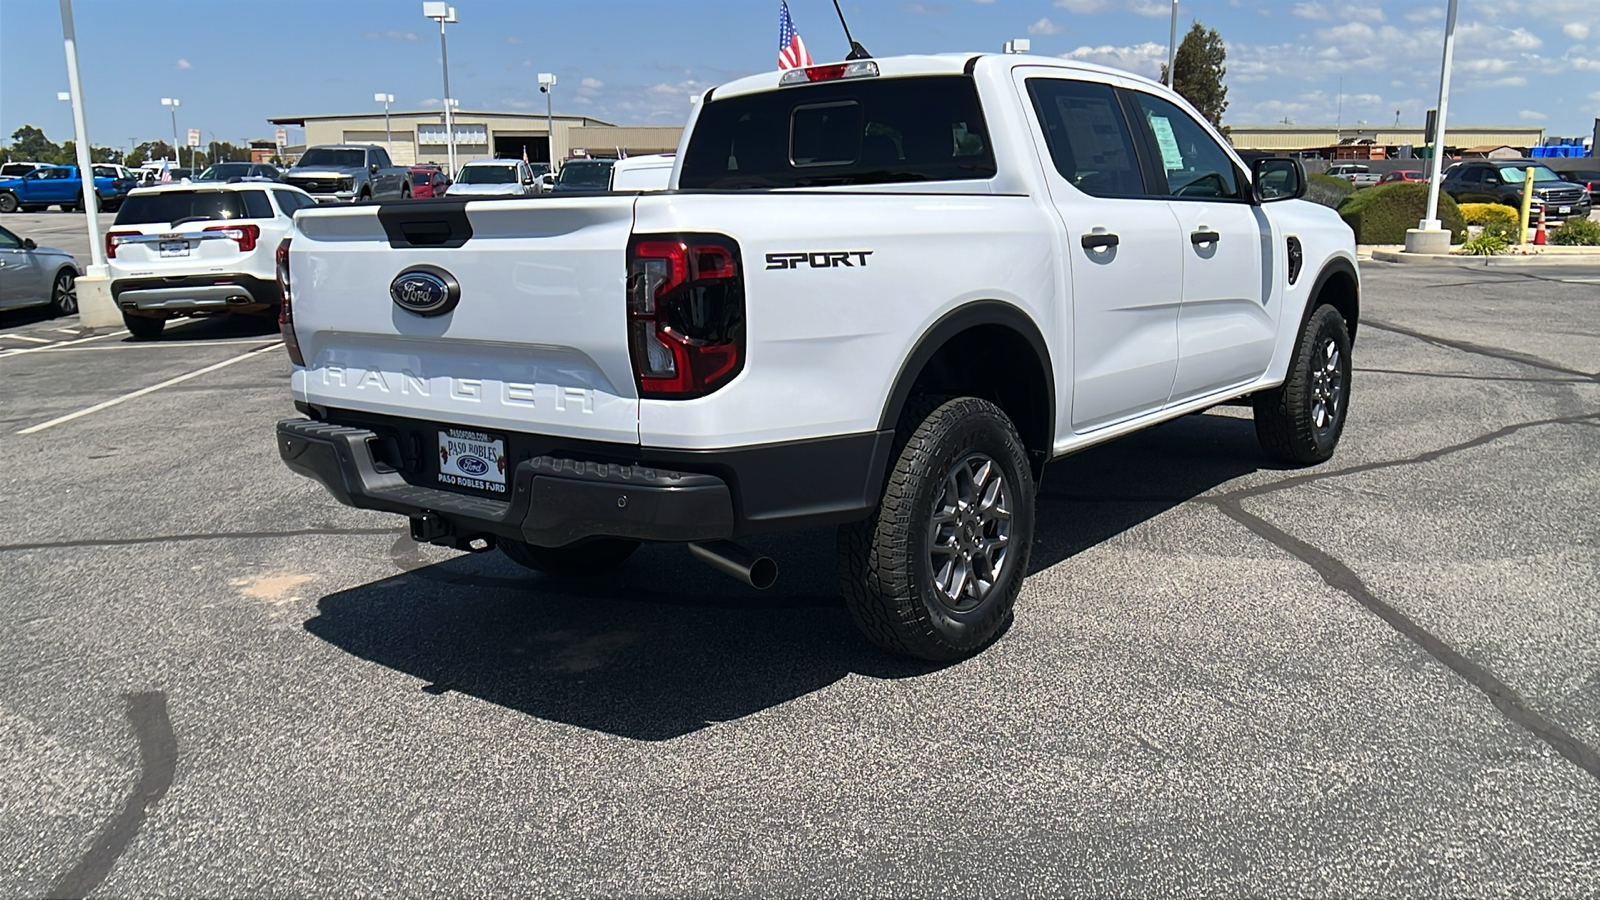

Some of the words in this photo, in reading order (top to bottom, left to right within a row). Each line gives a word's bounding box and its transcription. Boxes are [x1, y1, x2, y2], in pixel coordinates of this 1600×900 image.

[765, 250, 874, 271] SPORT
[401, 280, 432, 302] Ford
[322, 361, 595, 414] RANGER
[448, 441, 466, 456] PASO
[469, 443, 497, 463] ROBLES
[463, 458, 482, 472] Ford
[438, 473, 456, 485] PASO
[458, 477, 484, 489] ROBLES
[486, 482, 505, 492] FORD
